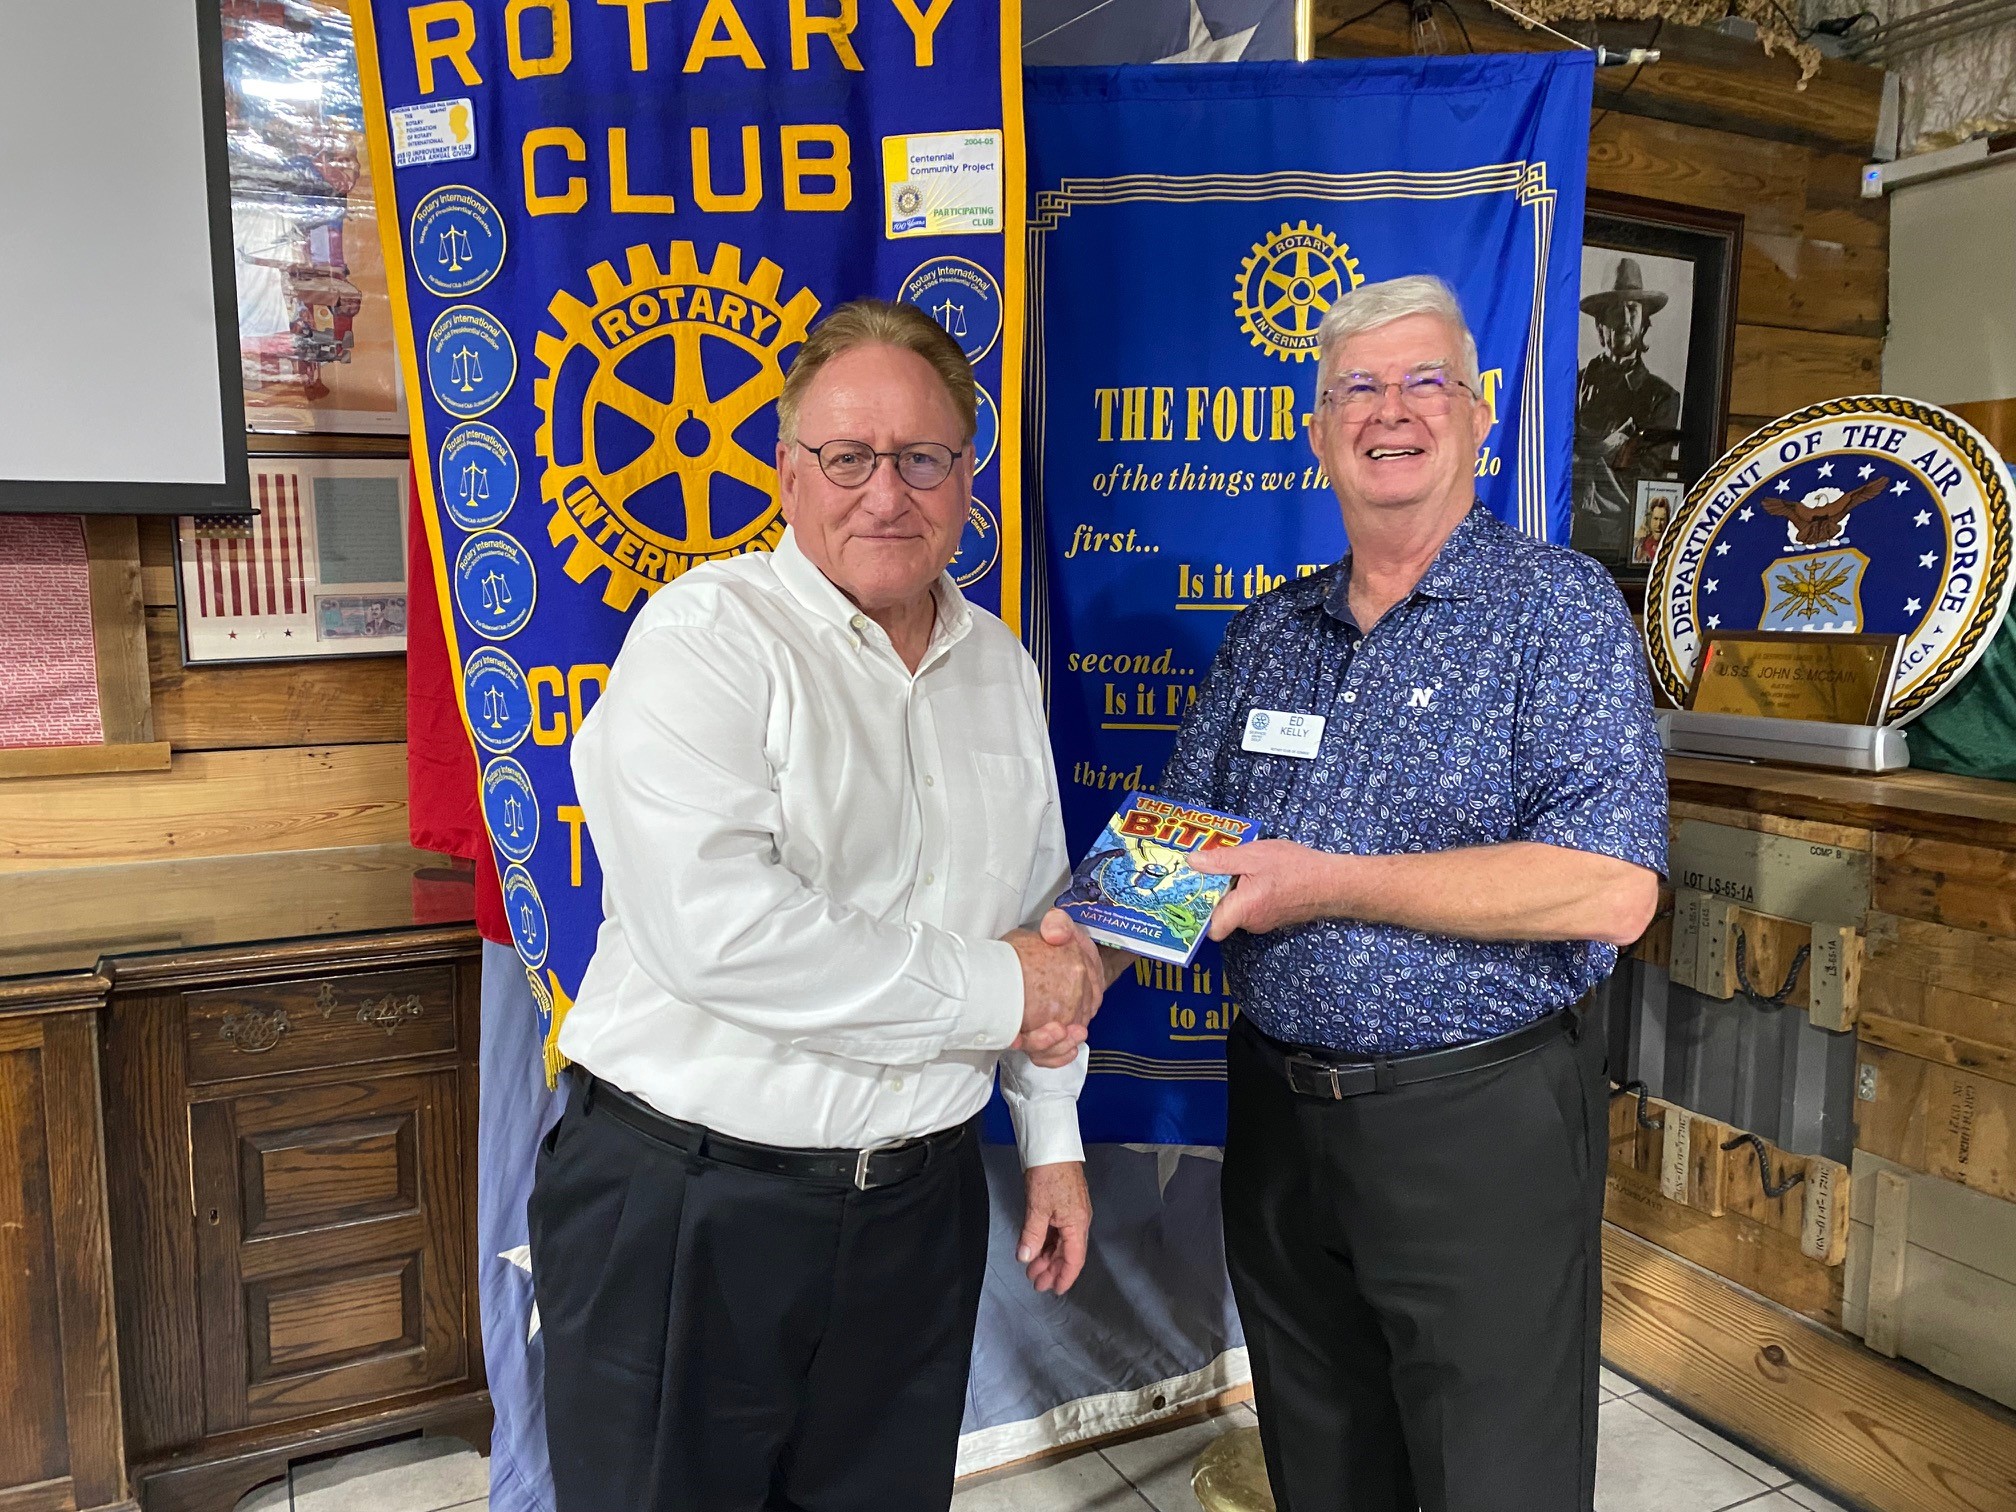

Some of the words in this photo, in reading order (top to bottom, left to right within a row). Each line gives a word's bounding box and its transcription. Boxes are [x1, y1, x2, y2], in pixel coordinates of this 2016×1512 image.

[408, 0, 956, 95] ROTARY
[964, 138, 994, 146] 2004-05
[522, 124, 852, 216] CLUB
[910, 152, 955, 163] Centennial
[910, 164, 959, 176] Community
[962, 163, 994, 173] Project
[416, 197, 440, 222] Rotary
[439, 193, 489, 215] International
[933, 206, 994, 217] PARTICIPATING
[972, 218, 994, 227] CLUB
[1275, 236, 1331, 254] ROTARY
[908, 269, 937, 292] Rotary
[937, 265, 991, 291] International
[432, 318, 453, 341] Rotary
[452, 313, 502, 338] International
[598, 287, 778, 345] ROTARY
[1254, 317, 1320, 348] INTERNATI
[1094, 386, 1175, 442] THE
[446, 432, 466, 453] Rotary
[465, 429, 508, 457] International
[1093, 464, 1122, 497] of
[1123, 464, 1162, 491] the
[1169, 463, 1255, 497] things
[1261, 469, 1297, 491] we
[1671, 461, 1764, 640] DEPARTMENT
[1779, 431, 1823, 463] OF
[1842, 425, 1908, 455] THE
[1911, 448, 1962, 497] AIR
[1940, 507, 1978, 615] FORCE
[459, 546, 477, 571] Rotary
[475, 539, 518, 557] International
[1178, 564, 1204, 599] Is
[1213, 563, 1235, 599] it
[1067, 648, 1195, 676] second...
[1757, 666, 1791, 680] JOHN
[527, 663, 611, 746] CO
[1104, 682, 1127, 716] Is
[1136, 682, 1157, 716] it
[1165, 684, 1198, 717] FA
[1407, 686, 1435, 708] N
[1279, 726, 1310, 738] KELLY
[1289, 715, 1305, 727] ED
[1137, 797, 1173, 816] THE
[1810, 845, 1833, 857] COMP
[1836, 850, 1842, 859] B
[1683, 870, 1704, 889] LOT
[1708, 876, 1754, 902] LS-65-1A
[1080, 910, 1130, 930] NATHAN
[1130, 924, 1163, 939] HALE
[1827, 939, 1837, 977] LS-65-1A
[1134, 956, 1184, 993] Will
[1193, 962, 1213, 995] it
[1169, 1001, 1197, 1030] to
